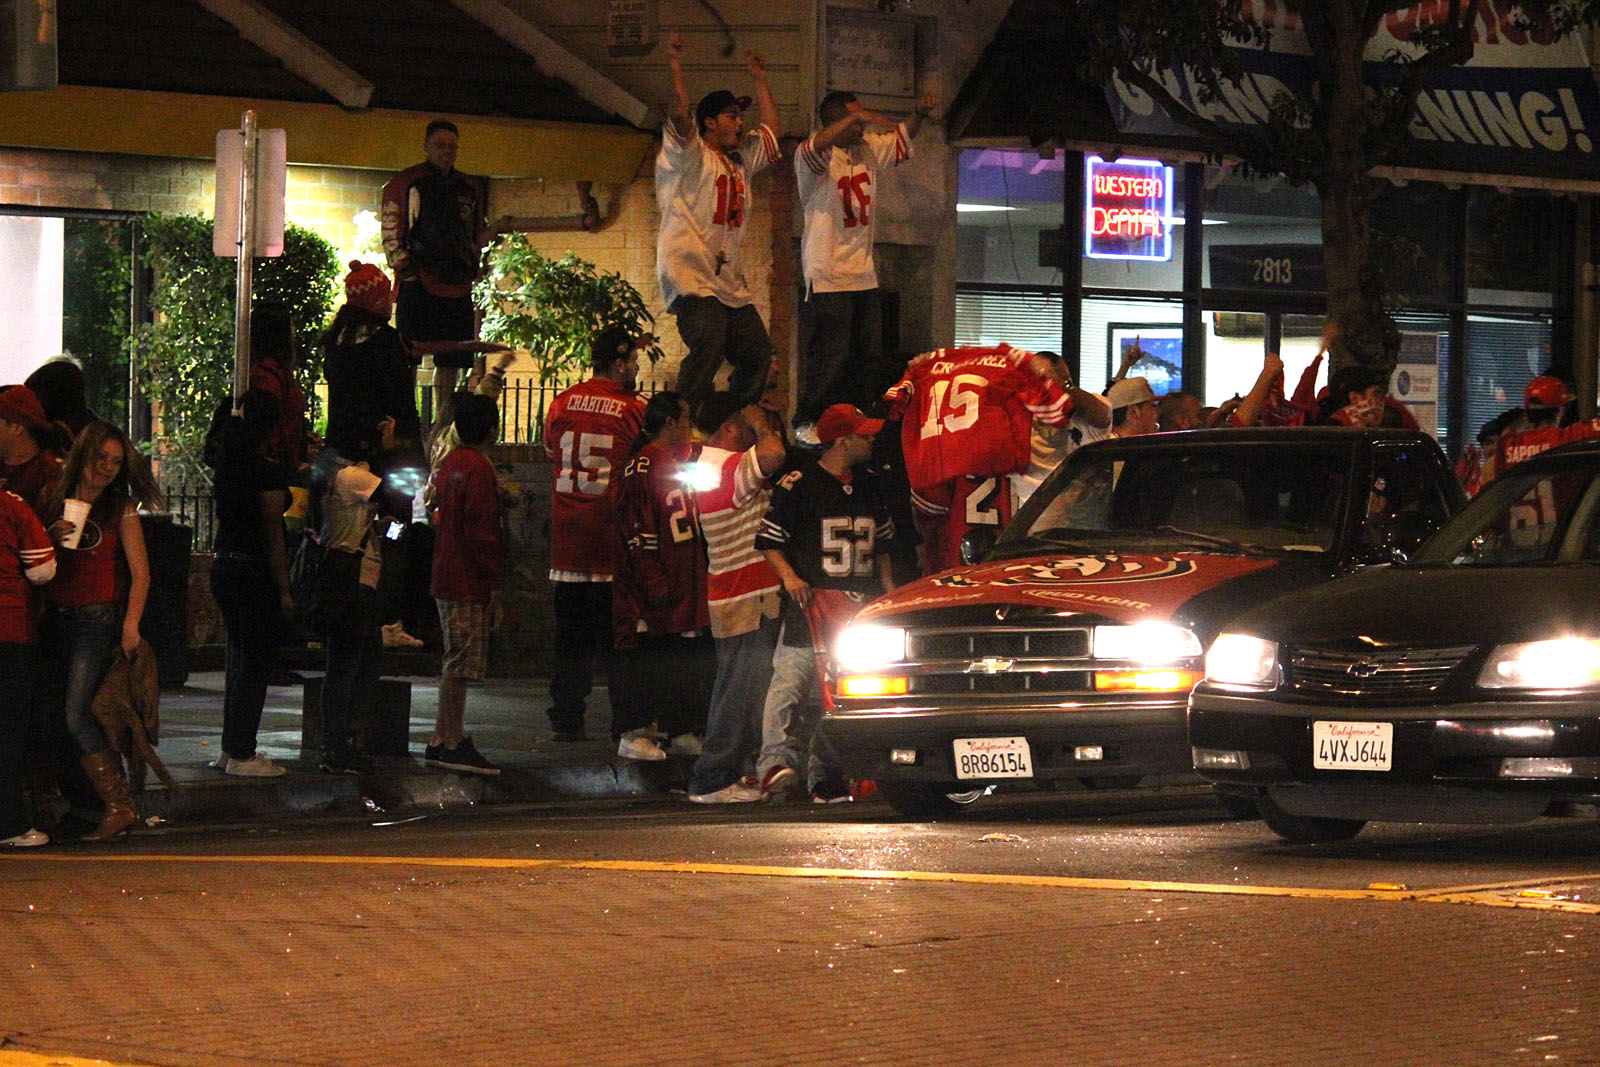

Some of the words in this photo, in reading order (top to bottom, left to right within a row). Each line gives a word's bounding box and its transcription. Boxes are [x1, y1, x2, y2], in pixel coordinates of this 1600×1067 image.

[1093, 174, 1163, 199] WESTERN
[1091, 207, 1163, 237] DENTAL
[1254, 257, 1293, 284] 2813
[567, 394, 627, 418] CRABTREE
[920, 374, 989, 440] 15
[556, 430, 615, 495] 15
[624, 456, 651, 477] 22
[821, 515, 876, 577] 52
[1083, 594, 1152, 610] LIGHT
[1331, 725, 1379, 739] California
[970, 741, 1016, 753] California
[1319, 739, 1386, 763] 4VXJ644
[960, 753, 1026, 774] 8R86154
